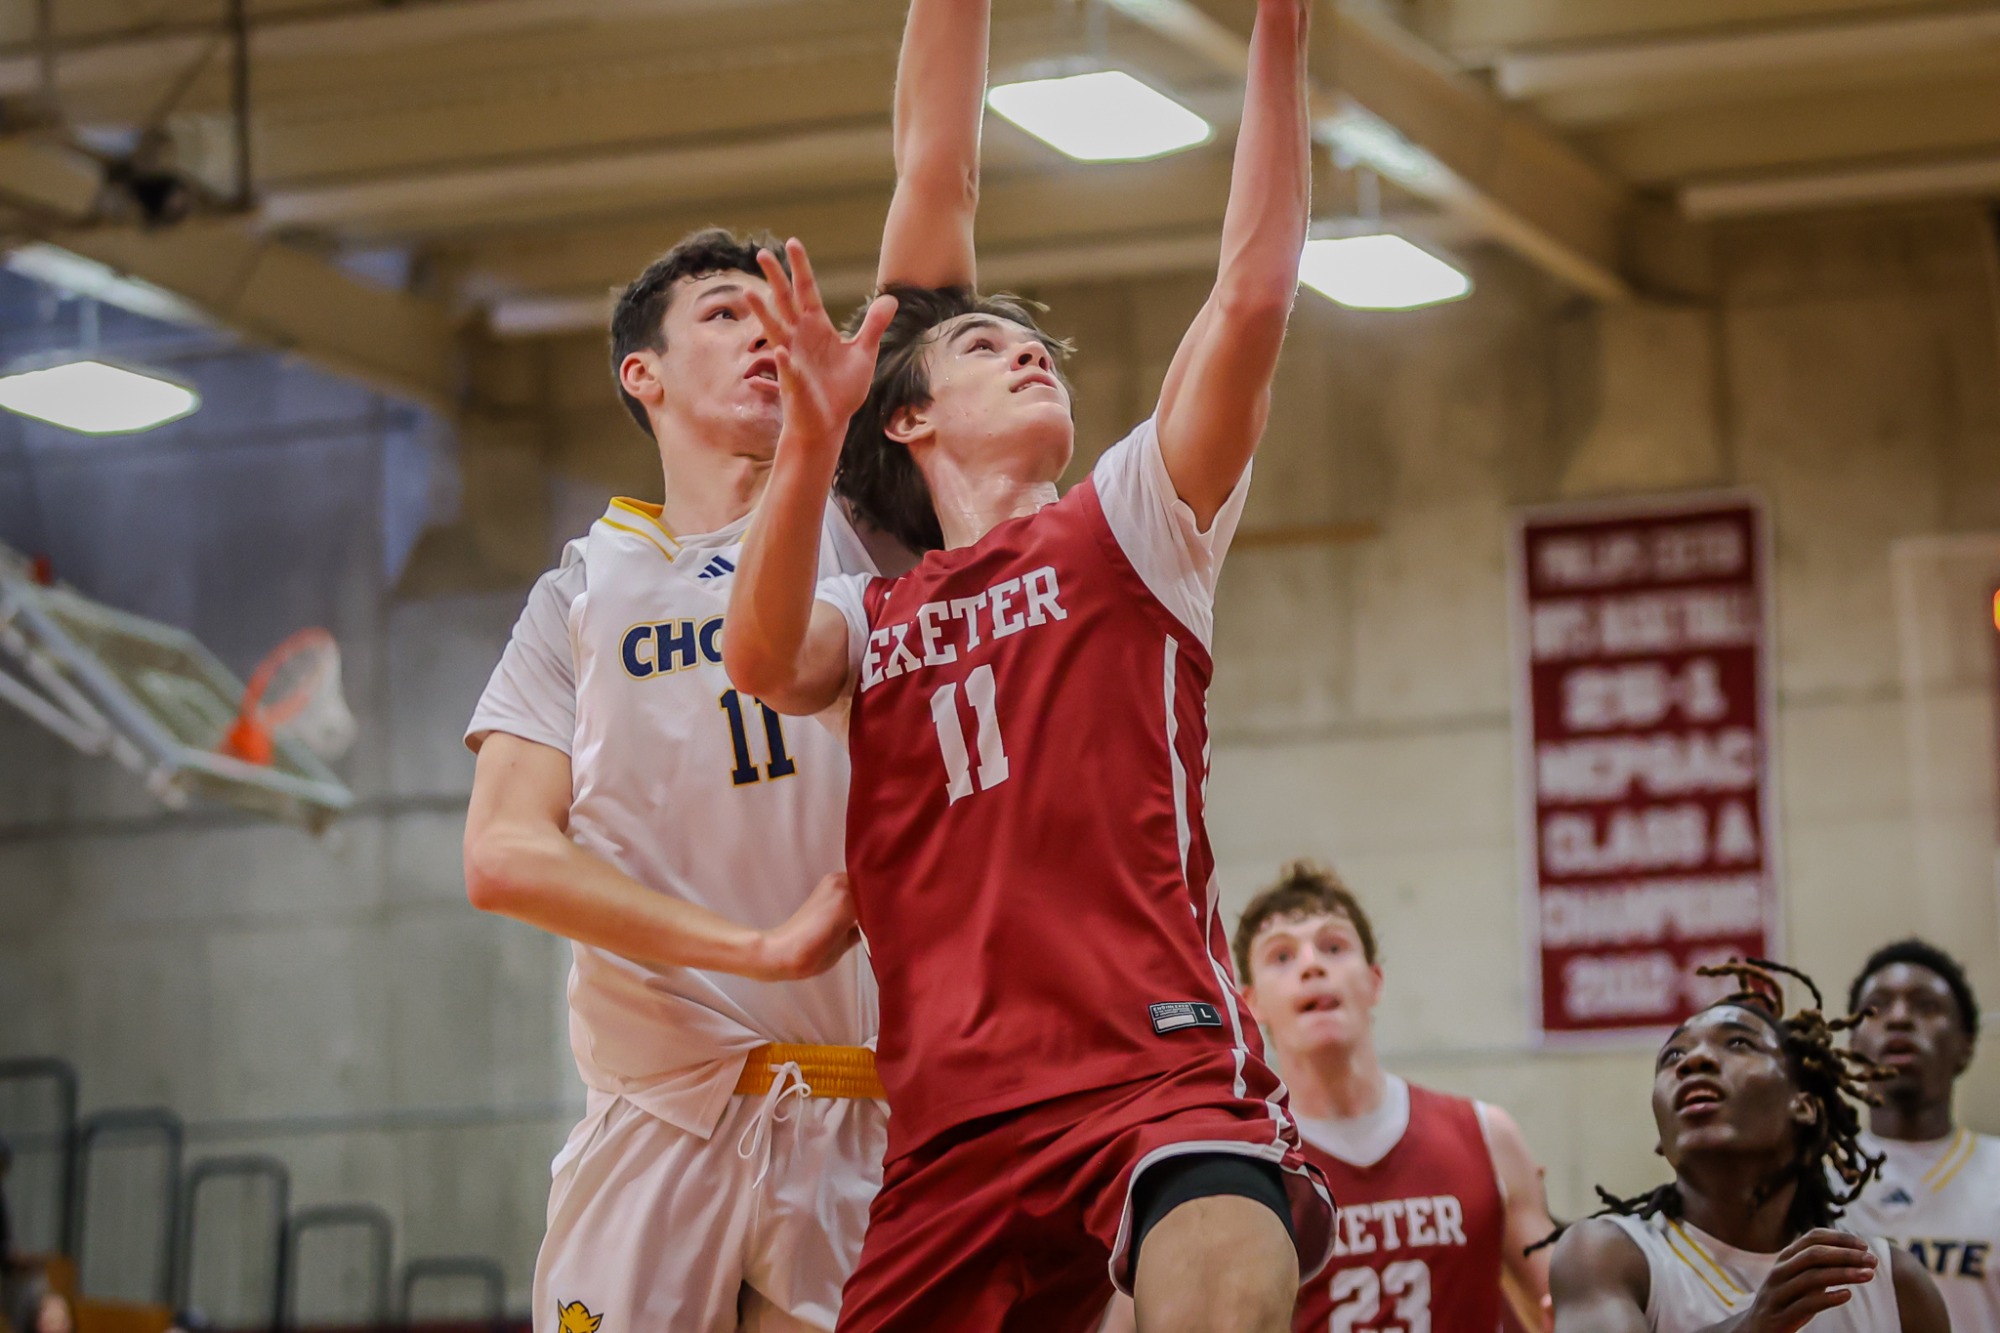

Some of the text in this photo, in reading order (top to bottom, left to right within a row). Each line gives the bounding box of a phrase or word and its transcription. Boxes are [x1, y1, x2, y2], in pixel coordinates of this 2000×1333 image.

[618, 614, 725, 681] CHO
[860, 565, 1068, 693] EXETER
[718, 688, 798, 788] 11
[930, 663, 1010, 806] 11
[1543, 797, 1759, 873] CLASS A
[1200, 1007, 1212, 1019] L
[1328, 1259, 1432, 1333] 23
[1908, 1237, 1990, 1281] ATE
